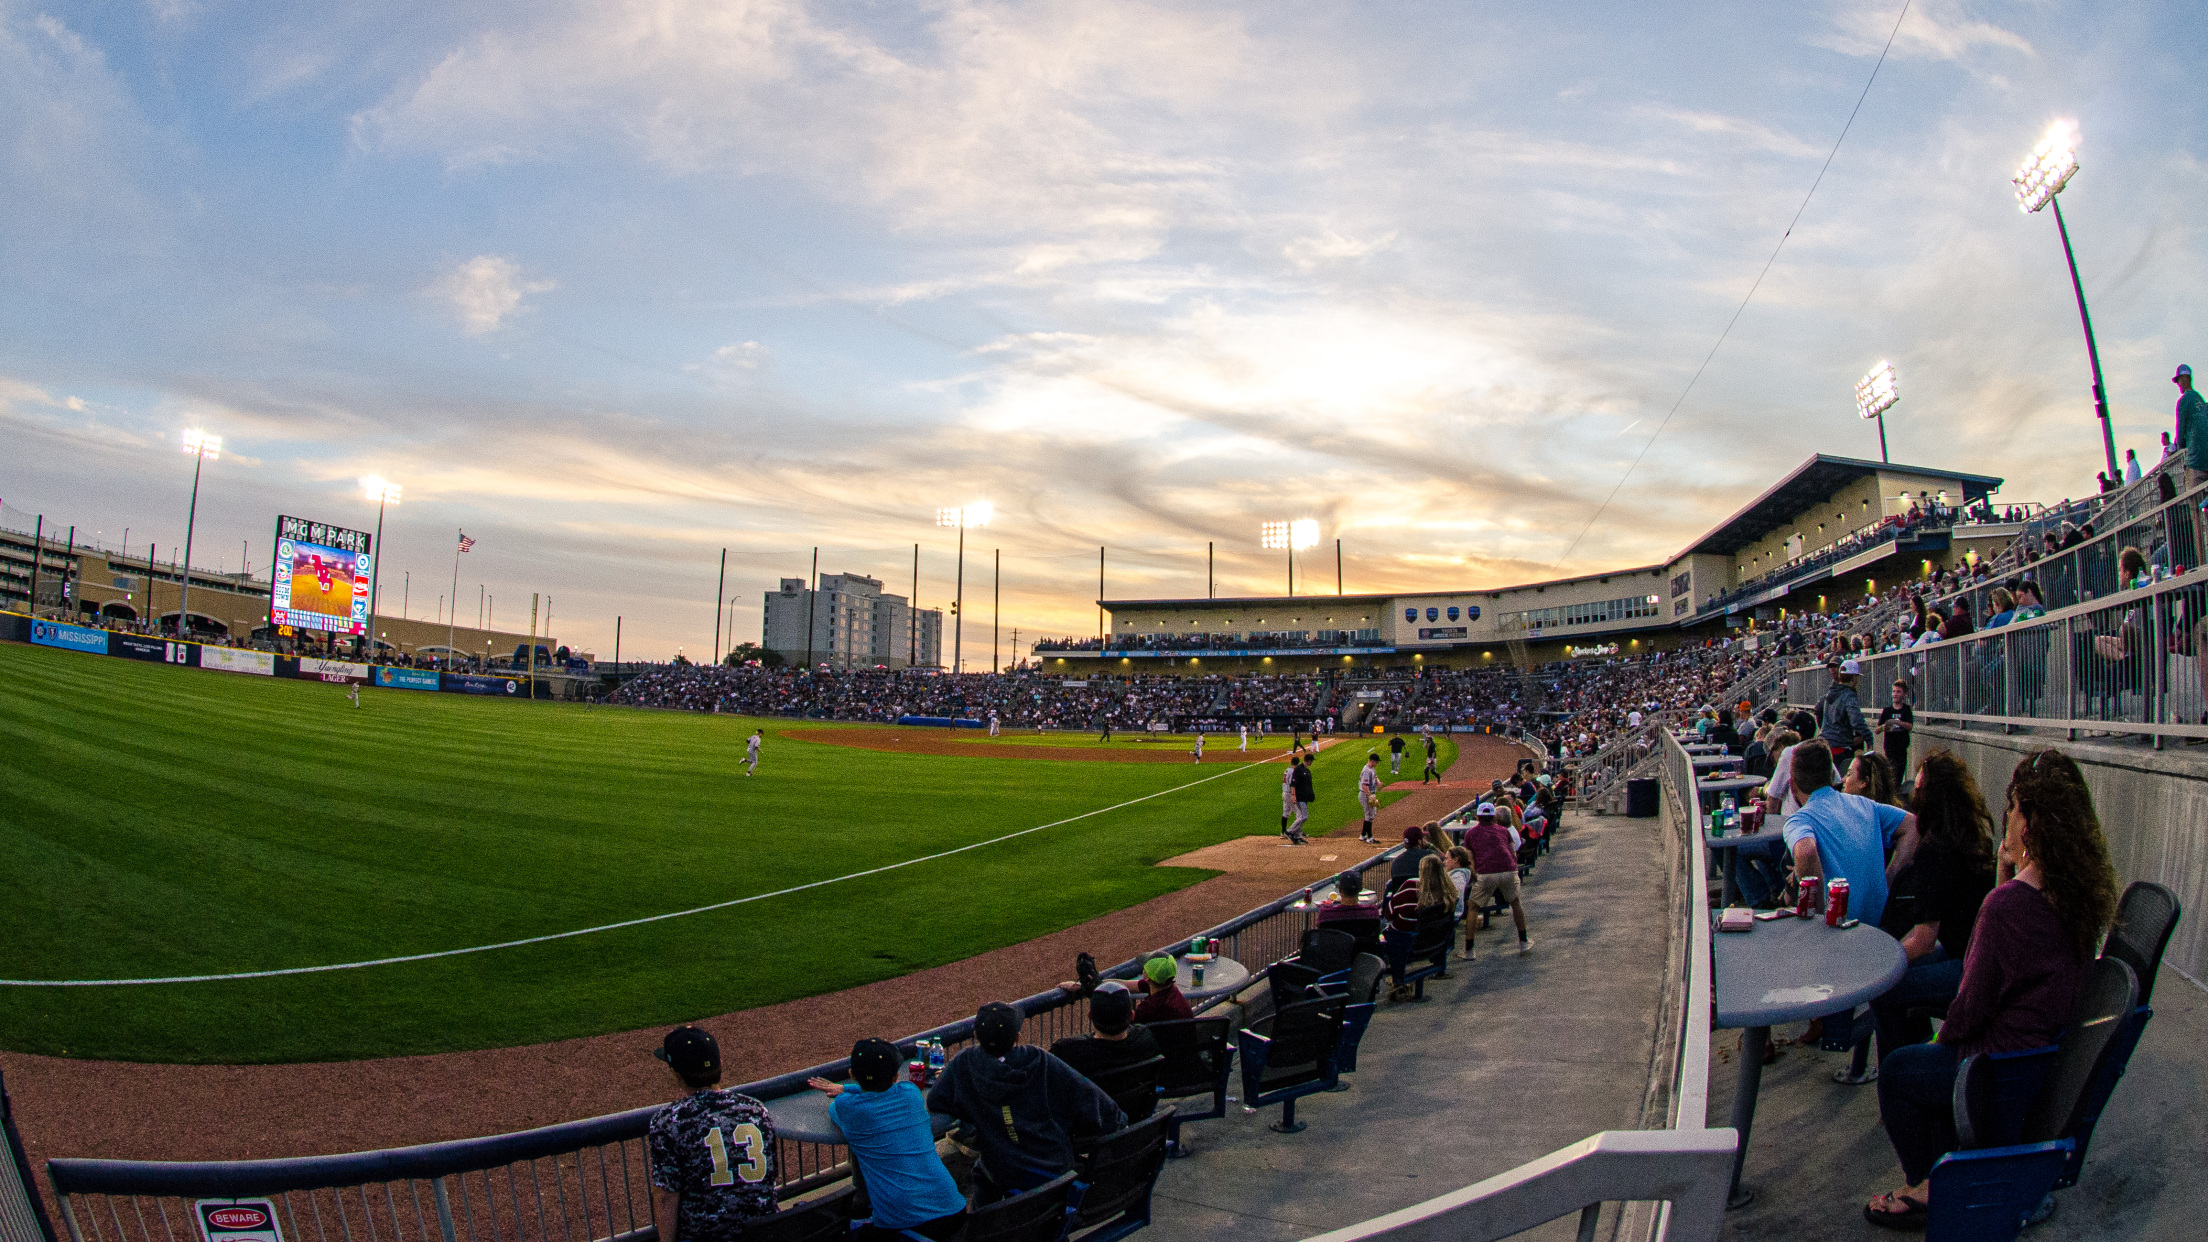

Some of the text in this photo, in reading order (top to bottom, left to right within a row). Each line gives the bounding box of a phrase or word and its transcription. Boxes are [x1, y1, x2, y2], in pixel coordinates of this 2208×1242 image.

[287, 521, 365, 548] MGM PARK
[58, 630, 106, 646] MISSISSIPPI
[315, 660, 353, 676] Yuengling
[322, 673, 346, 683] LAGER
[704, 1122, 767, 1187] 13
[215, 1213, 260, 1223] BEWARE
